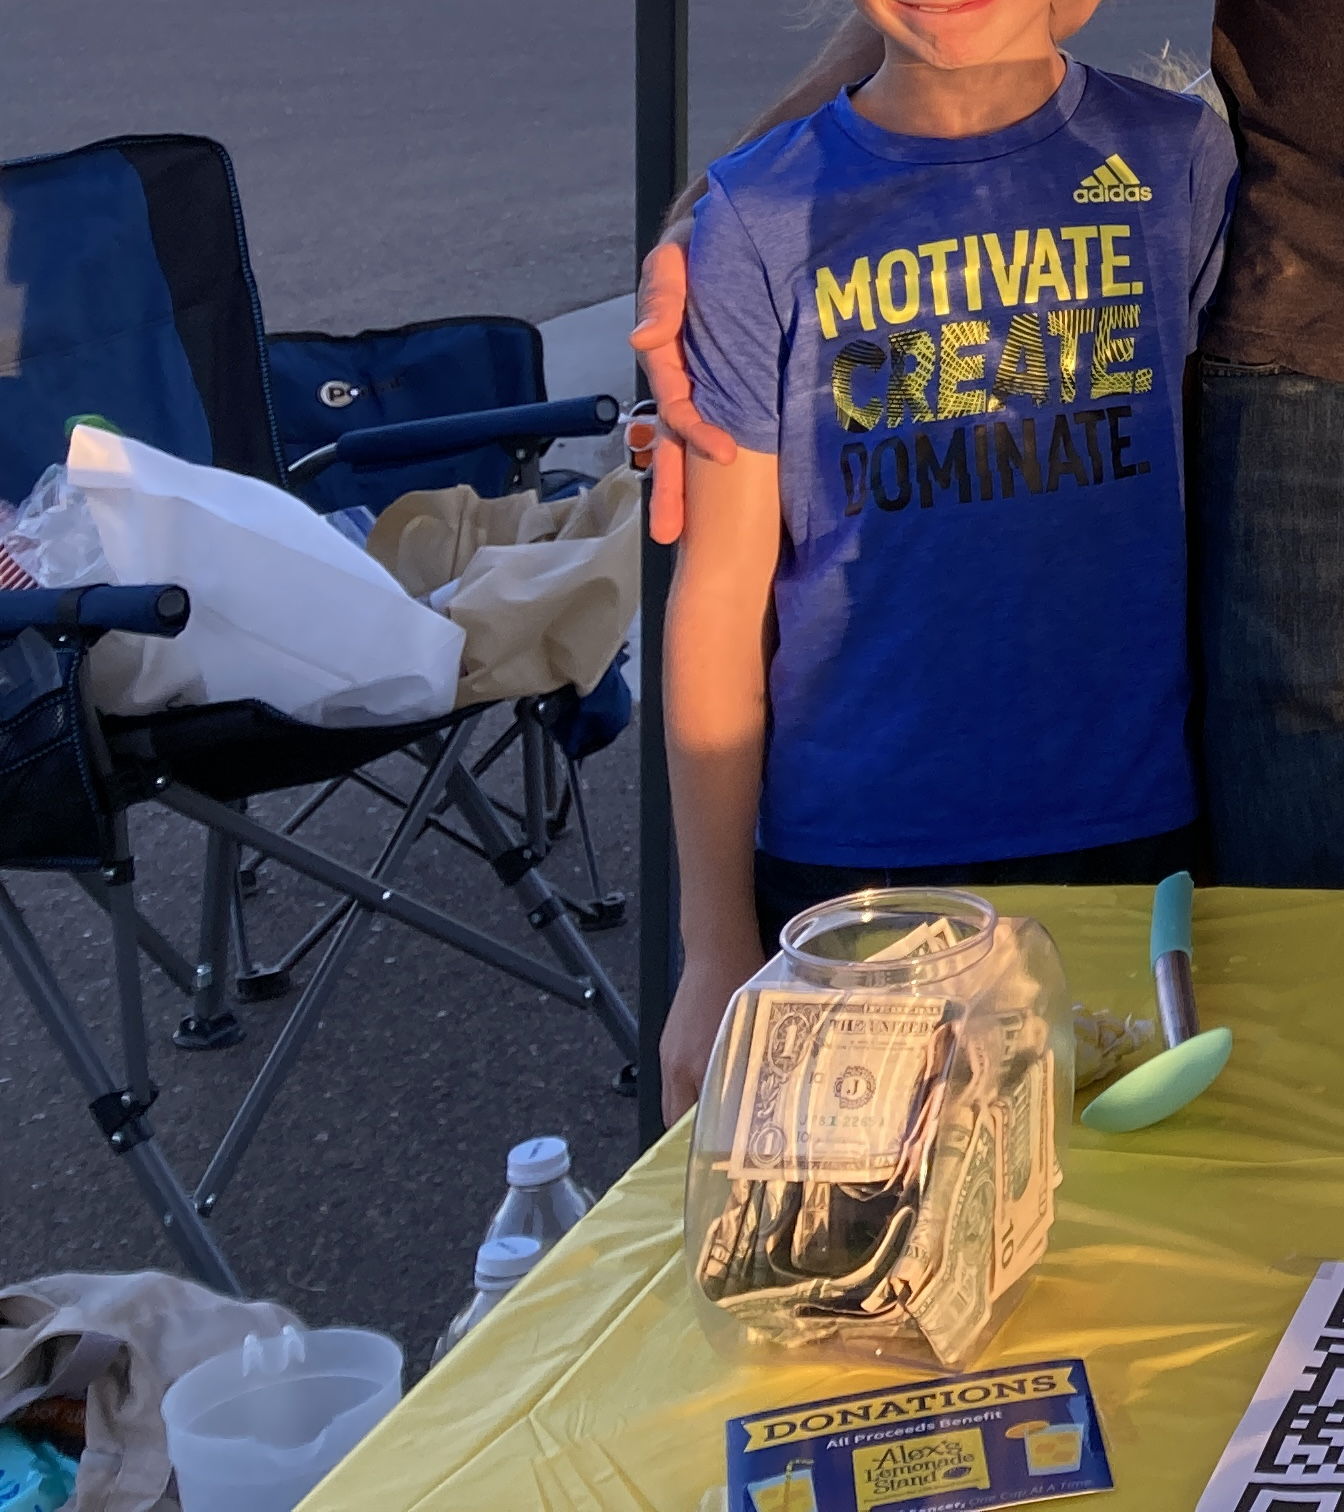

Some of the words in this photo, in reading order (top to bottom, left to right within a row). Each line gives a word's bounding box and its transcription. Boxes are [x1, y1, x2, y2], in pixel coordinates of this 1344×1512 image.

[1073, 182, 1153, 204] adidas
[815, 224, 1144, 340] MOTIVATE.
[830, 302, 1154, 434] CREATE.
[839, 405, 1152, 518] DOMINATE.
[868, 1020, 932, 1035] UNITED
[846, 1078, 859, 1095] J
[1001, 1217, 1014, 1270] 10
[762, 1374, 1058, 1443] DONATIONS
[826, 1436, 850, 1450] All
[853, 1421, 936, 1443] Proceeds
[938, 1410, 1003, 1430] Benefit
[866, 1453, 976, 1484] Lemonade
[873, 1439, 963, 1471] Alex's
[872, 1469, 938, 1496] Stand
